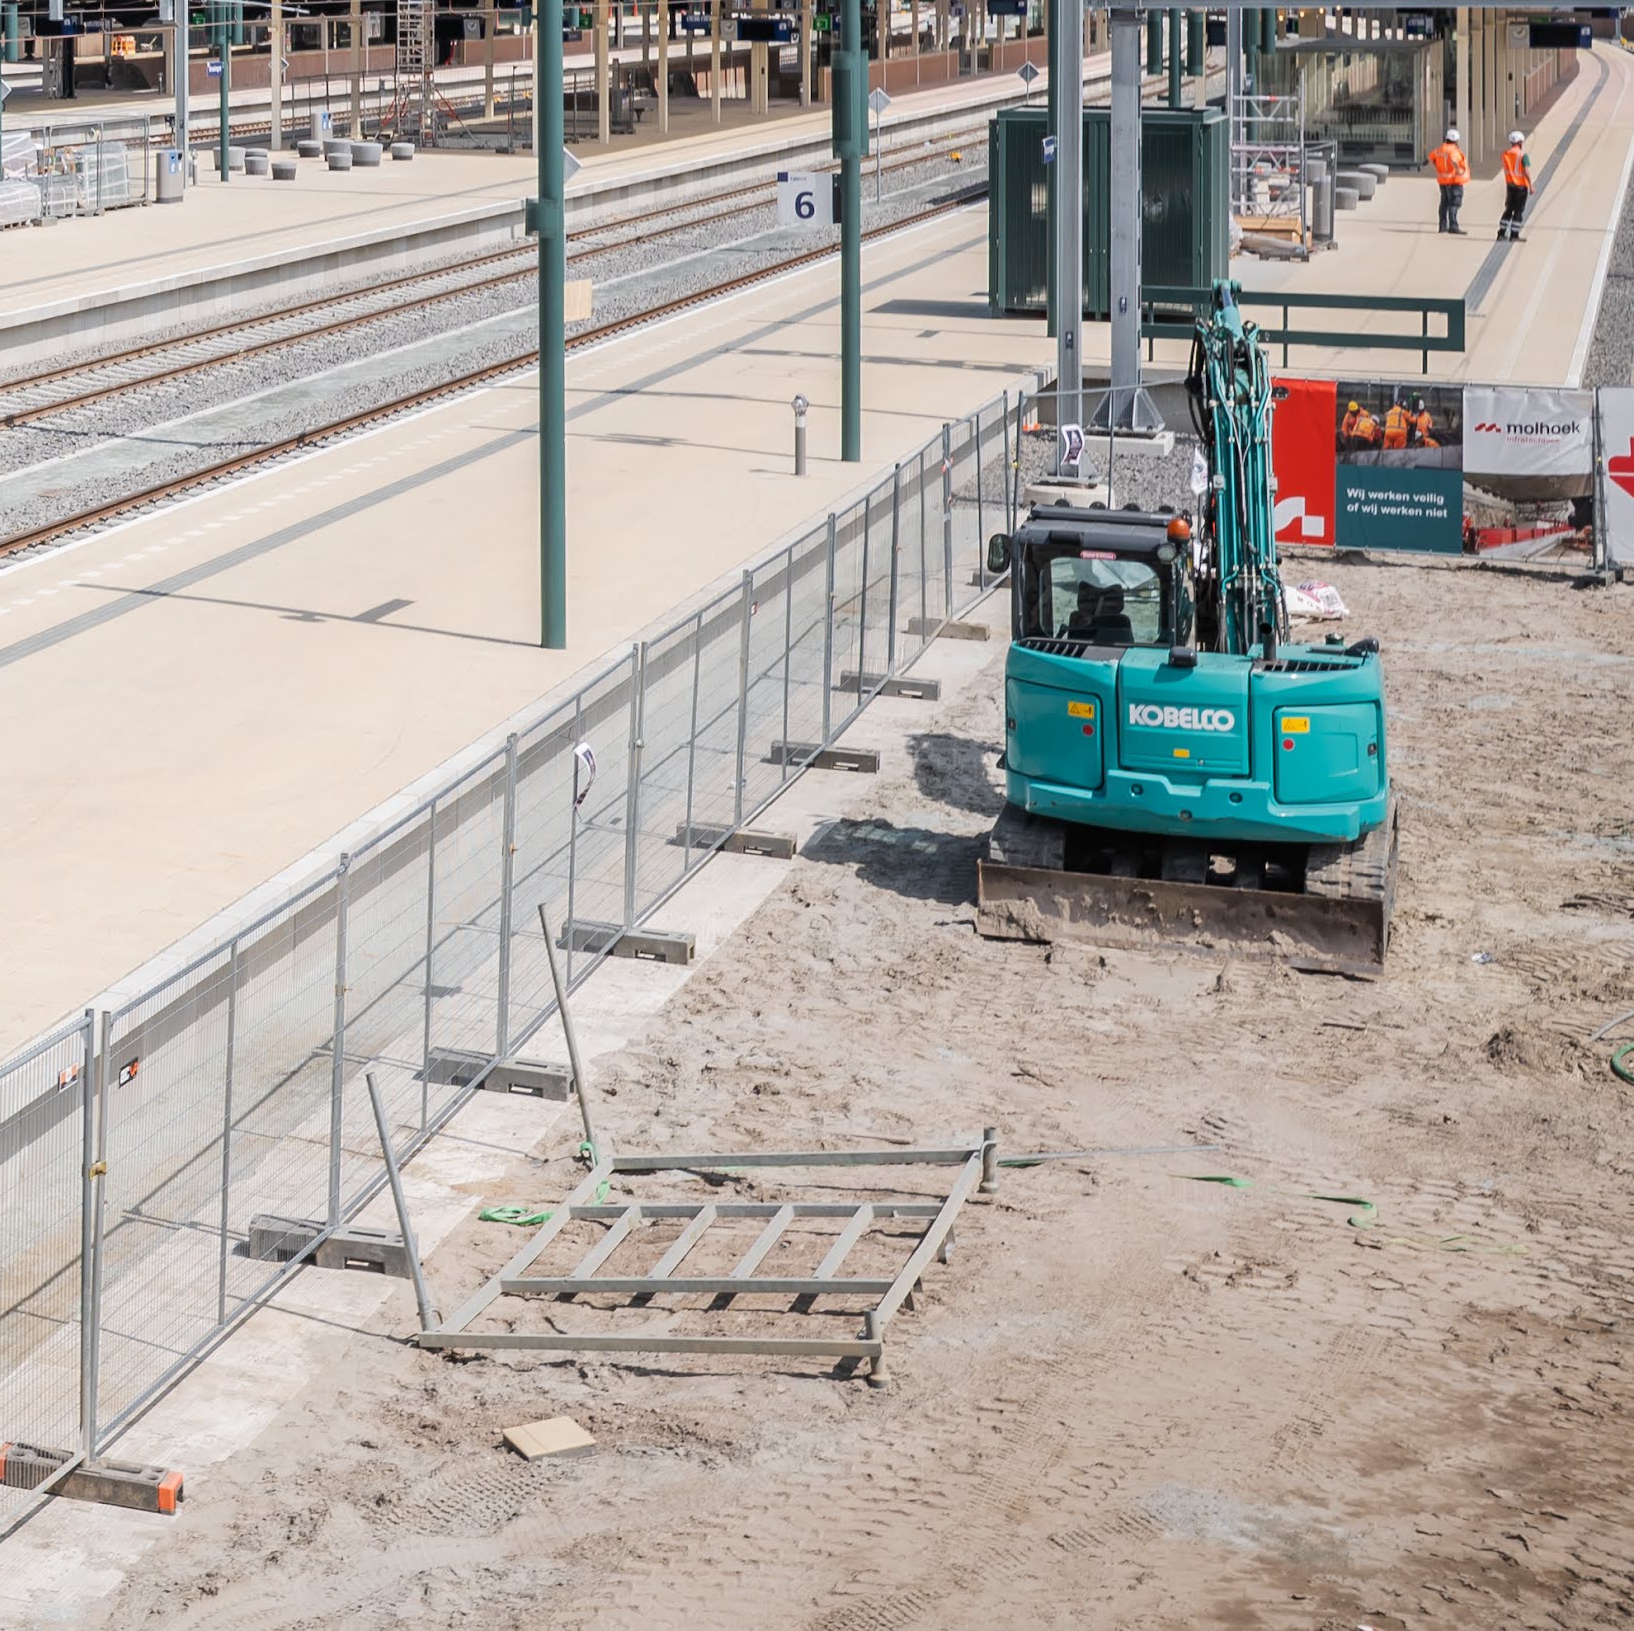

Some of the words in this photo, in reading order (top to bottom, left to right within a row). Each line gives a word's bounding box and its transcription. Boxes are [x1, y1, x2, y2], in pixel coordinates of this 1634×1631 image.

[794, 191, 815, 220] 6
[1506, 420, 1581, 436] molhoek
[1346, 487, 1365, 501] Wij
[1367, 490, 1410, 502] werken
[1412, 492, 1445, 506] veilig
[1346, 502, 1359, 512] of
[1361, 503, 1378, 516] wij
[1380, 505, 1422, 517] werken
[1425, 507, 1448, 518] niet
[1128, 703, 1236, 732] KOBELCO
